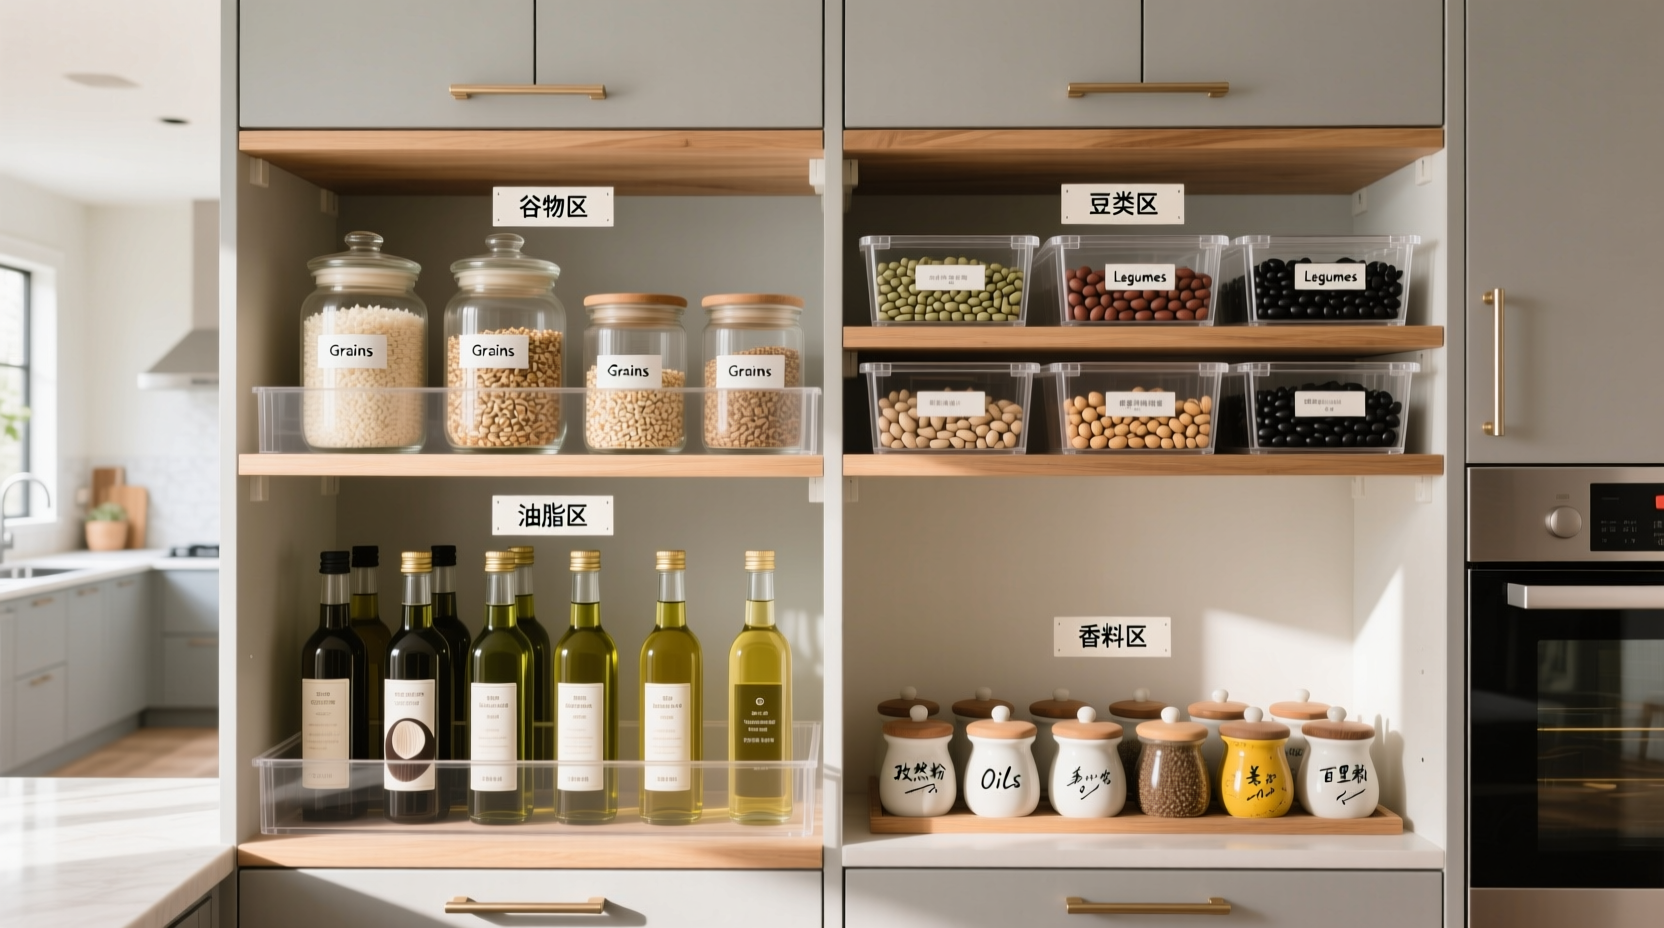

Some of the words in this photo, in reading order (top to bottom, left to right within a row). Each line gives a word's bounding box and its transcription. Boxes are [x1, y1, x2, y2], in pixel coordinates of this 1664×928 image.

[519, 194, 588, 219] 谷物区
[1089, 191, 1159, 217] 豆类区
[1113, 265, 1167, 287] Legumes
[1304, 265, 1358, 286] Legumes
[329, 343, 374, 359] Grains
[471, 343, 515, 359] Grains
[607, 363, 650, 379] Grains
[728, 363, 772, 379] Grains
[517, 501, 588, 528] 油脂区
[1078, 623, 1147, 649] 香料区
[980, 766, 1022, 790] Oils
